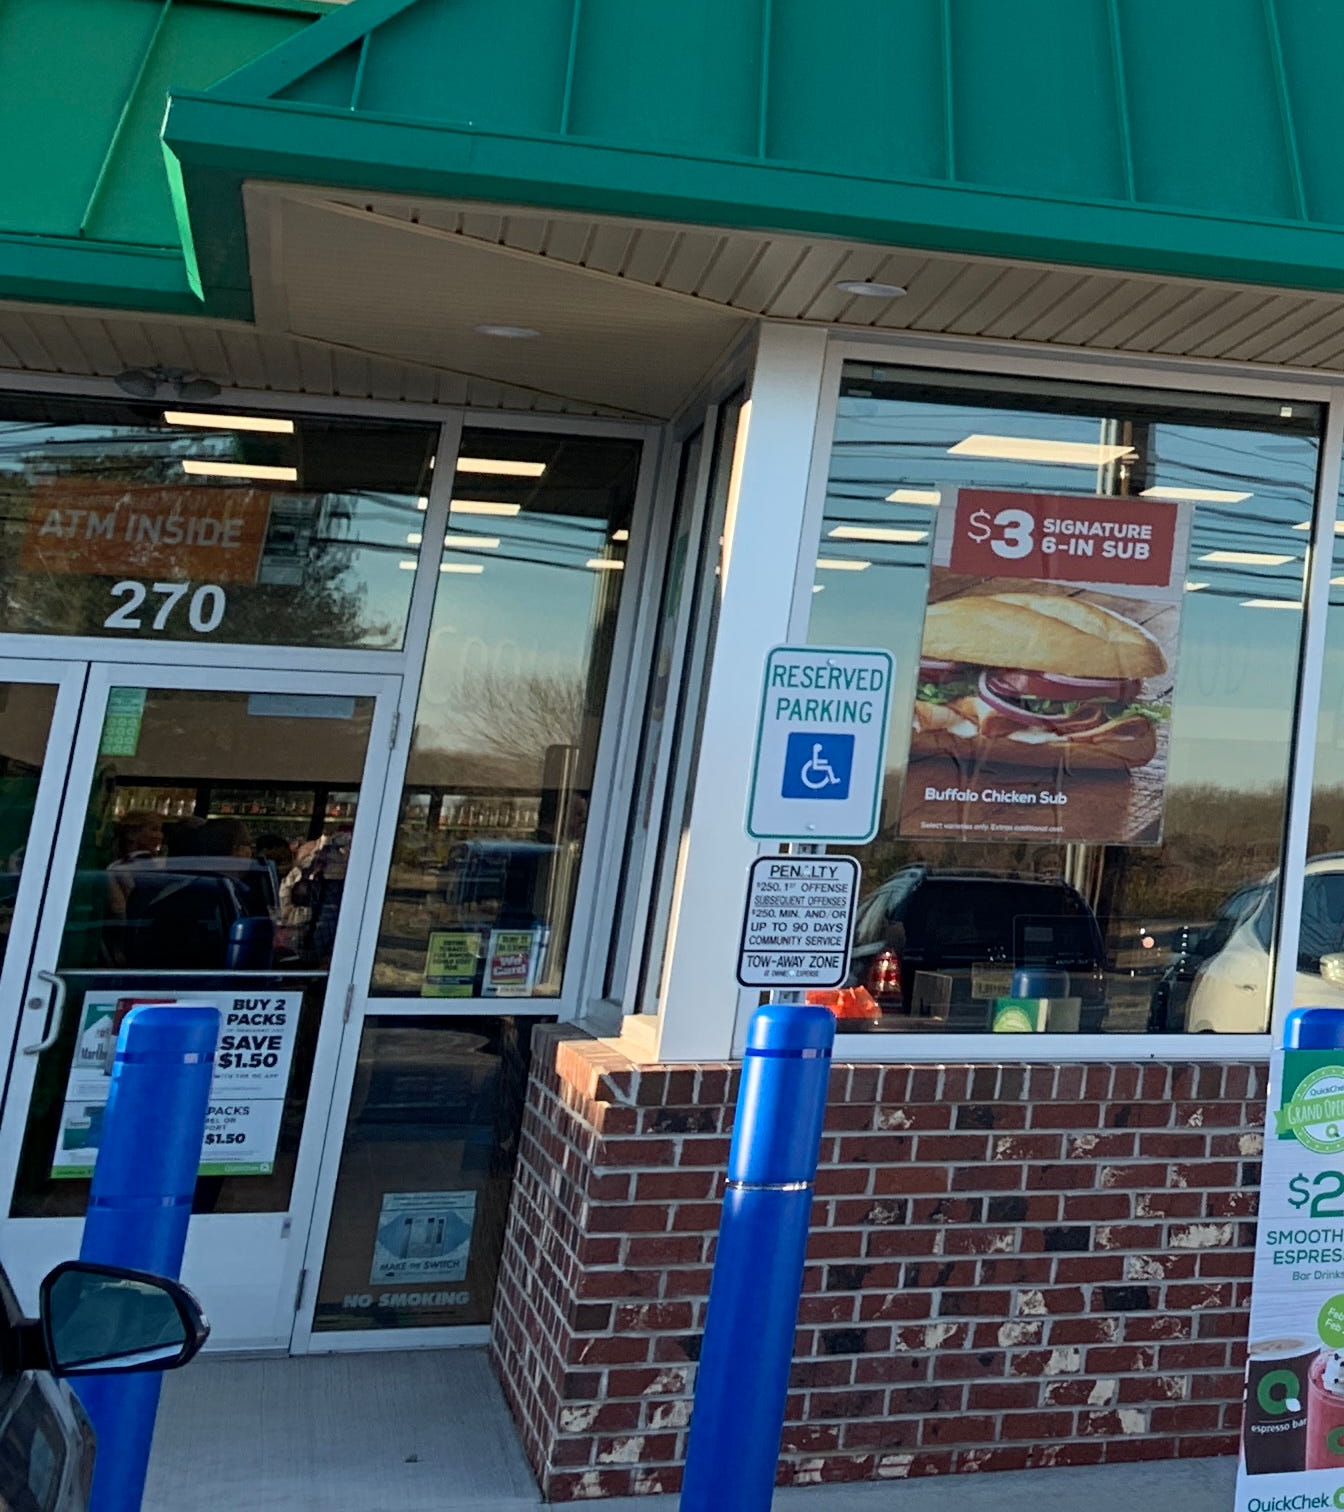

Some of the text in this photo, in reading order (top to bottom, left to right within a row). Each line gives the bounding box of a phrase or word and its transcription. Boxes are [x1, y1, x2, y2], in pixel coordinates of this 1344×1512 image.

[38, 508, 245, 548] ATM INSIDE
[968, 508, 1152, 559] $3 SIGNATURE
[1042, 537, 1150, 560] 6-IN SUB
[104, 580, 226, 632] 270
[772, 665, 883, 691] RESERVED
[776, 698, 872, 723] PARKING
[924, 787, 1068, 805] Buffalo Chicken Sub
[801, 882, 848, 893] OFFENSE
[754, 895, 847, 906] SUBSEQUENT OFFENSES
[751, 922, 843, 933] UP TO 90 DAYS
[749, 935, 841, 946] COMMUNITY SERVICE
[747, 955, 839, 968] TOW-AWAY ZONE
[233, 999, 286, 1011] BUY 2
[227, 1014, 286, 1025] PACKS
[220, 1035, 282, 1050] SAVE
[218, 1052, 278, 1069] $1.50
[207, 1106, 250, 1116] PACKS
[1288, 1103, 1322, 1125] GRAND
[205, 1133, 245, 1145] $1.50
[423, 1260, 460, 1270] SWITCH
[1292, 1271, 1311, 1281] Bar
[343, 1291, 470, 1308] NO SMOKING
[1328, 1307, 1344, 1321] Feb
[1325, 1318, 1341, 1333] Feb
[1251, 1418, 1307, 1435] espresso bar
[1248, 1492, 1329, 1512] QuickChek
